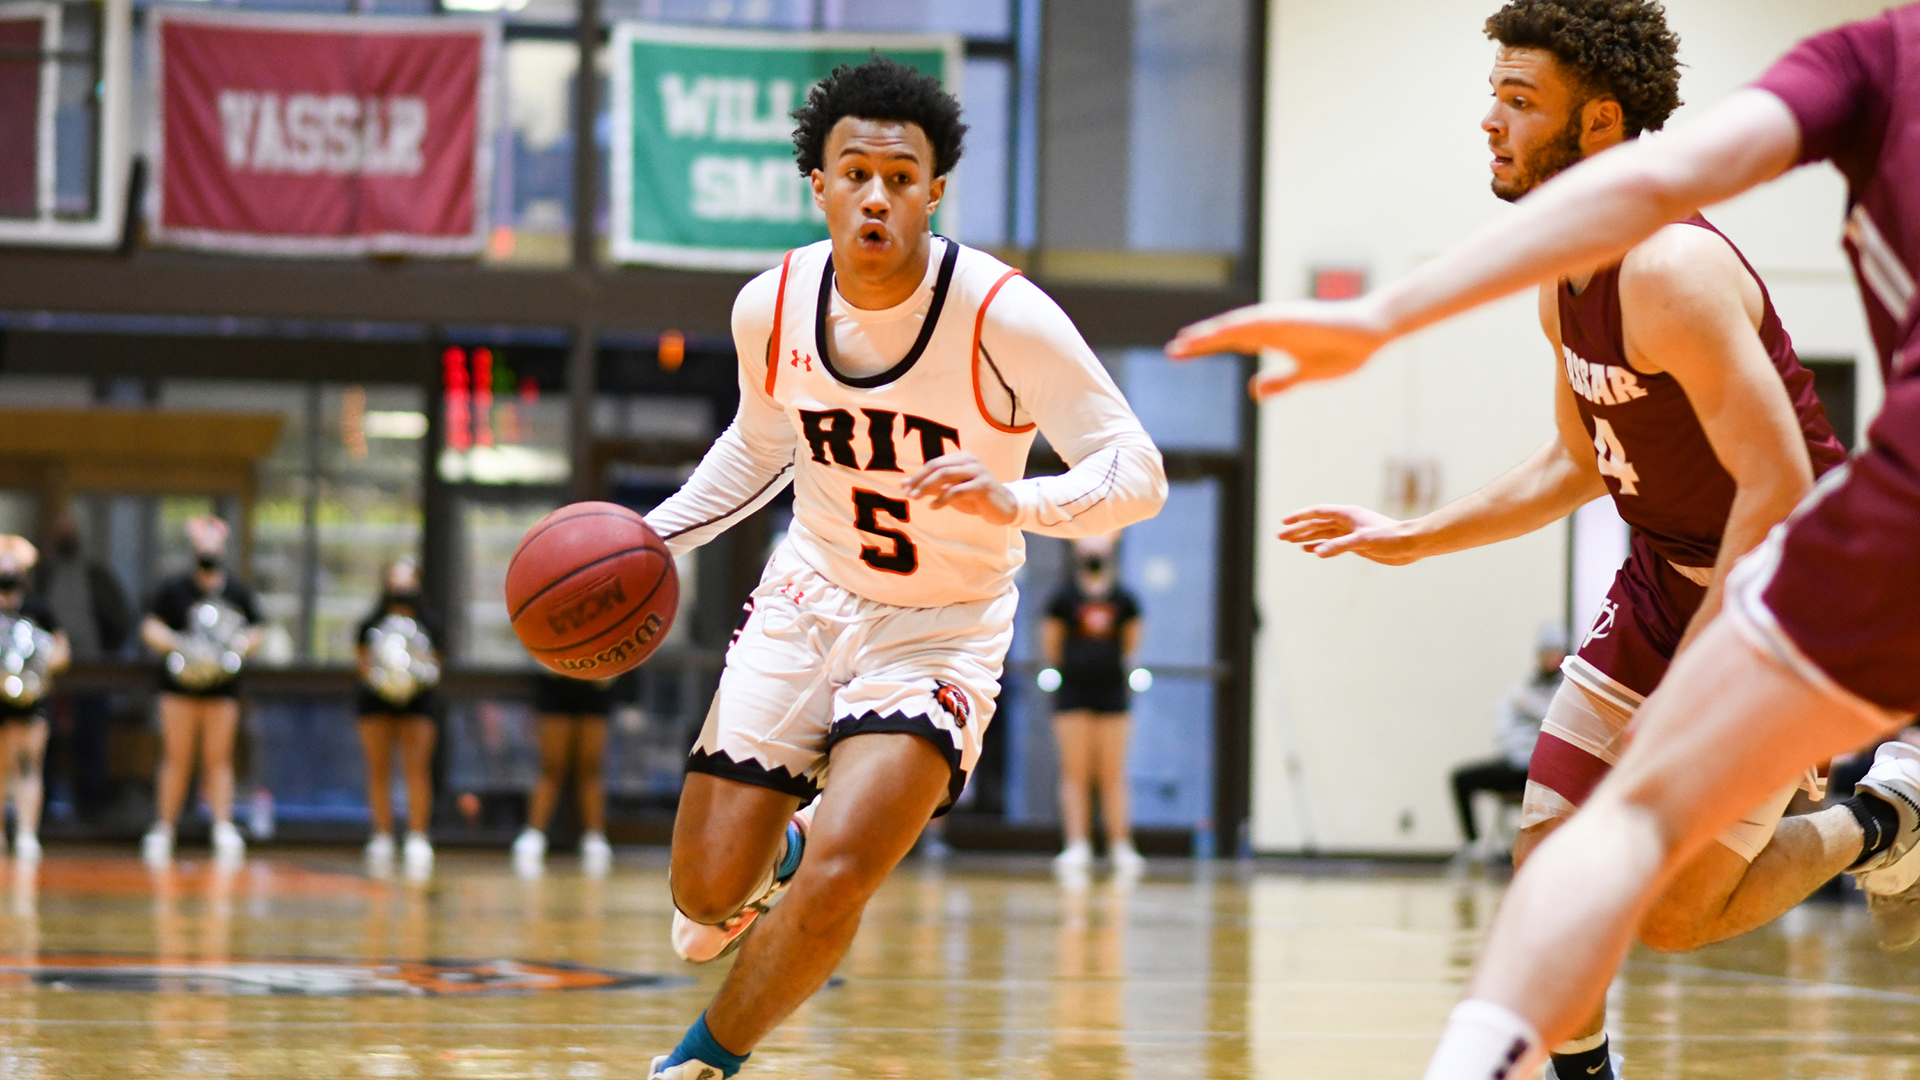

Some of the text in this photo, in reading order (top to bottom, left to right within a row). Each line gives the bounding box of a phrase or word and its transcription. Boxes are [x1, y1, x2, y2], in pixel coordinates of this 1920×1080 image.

[218, 87, 429, 175] VASSAR
[1562, 343, 1649, 406] ASSAR
[798, 408, 961, 473] RIT
[1592, 414, 1640, 496] 4
[851, 486, 919, 576] 5
[546, 576, 628, 637] NCAA
[555, 611, 665, 672] Wilson
